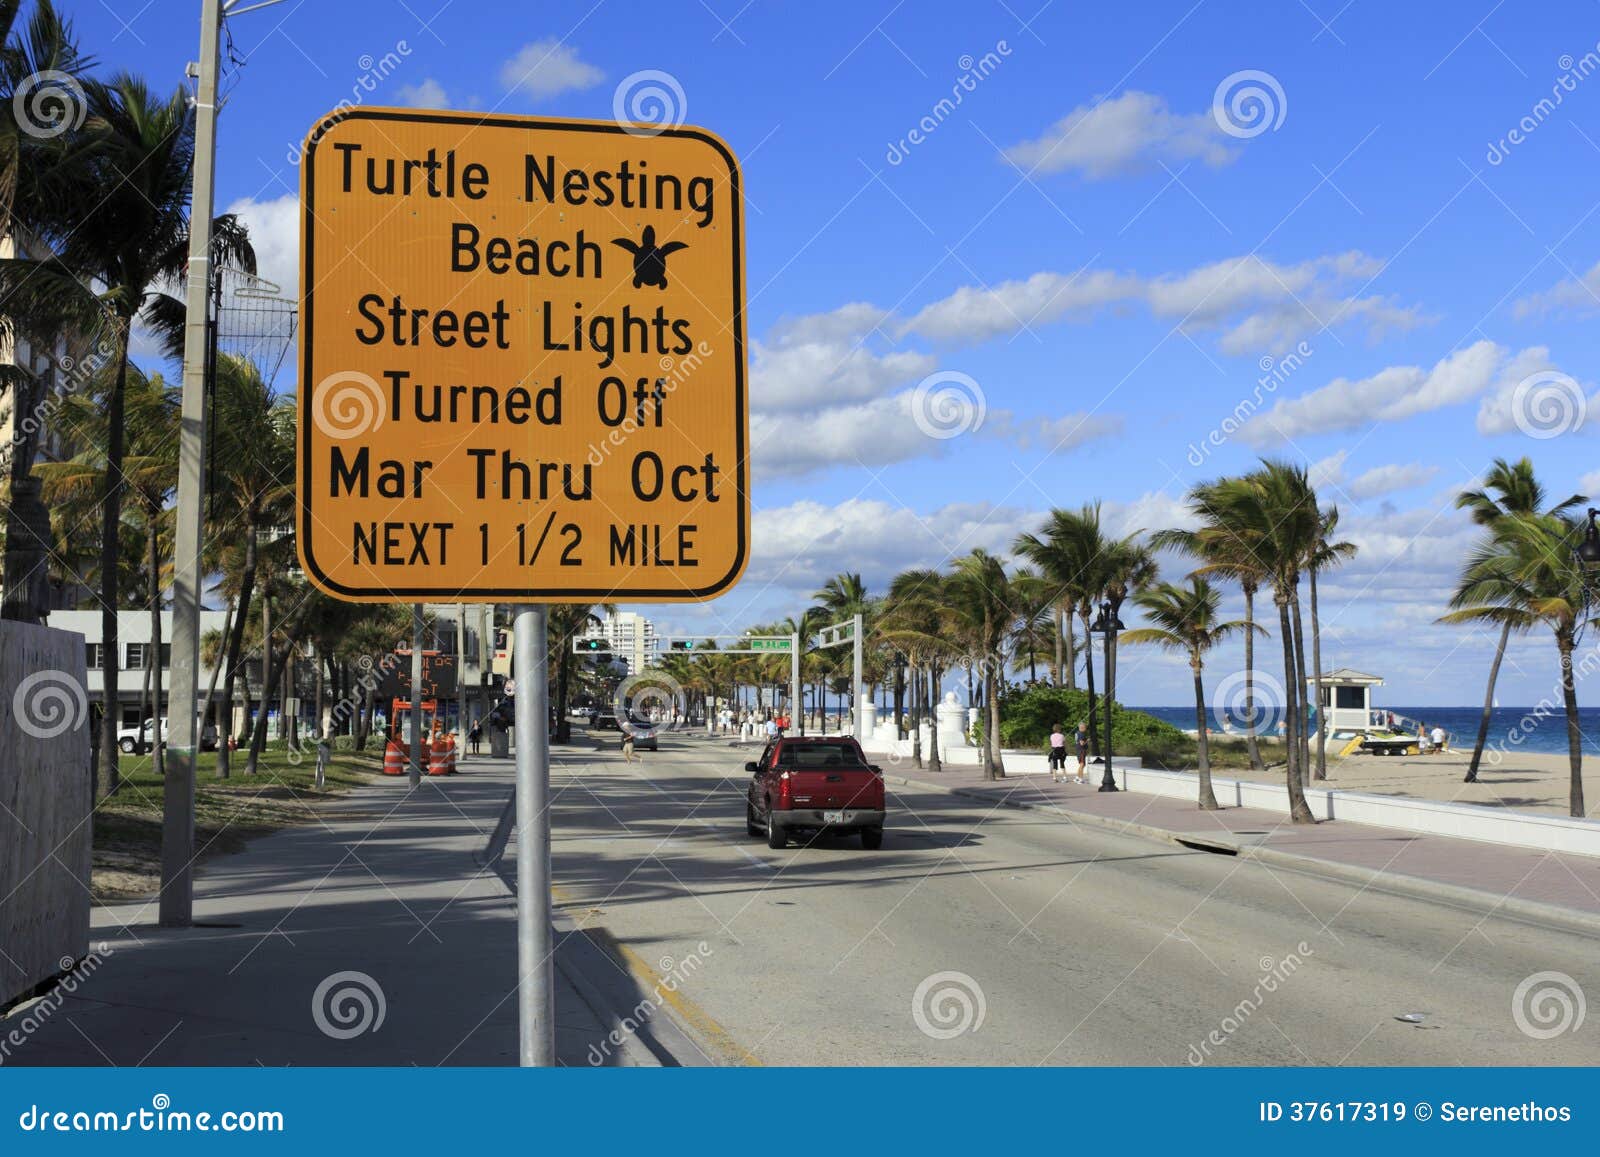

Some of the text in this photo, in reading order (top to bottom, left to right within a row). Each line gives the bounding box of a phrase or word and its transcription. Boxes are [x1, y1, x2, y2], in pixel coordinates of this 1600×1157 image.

[335, 143, 714, 228] Turtle Nesting
[451, 223, 602, 278] Beach
[355, 294, 693, 368] Street Lights
[383, 371, 667, 427] Turned Off
[330, 446, 720, 503] Mar Thru Oct
[353, 511, 698, 566] NEXT 1 1/2 MILE
